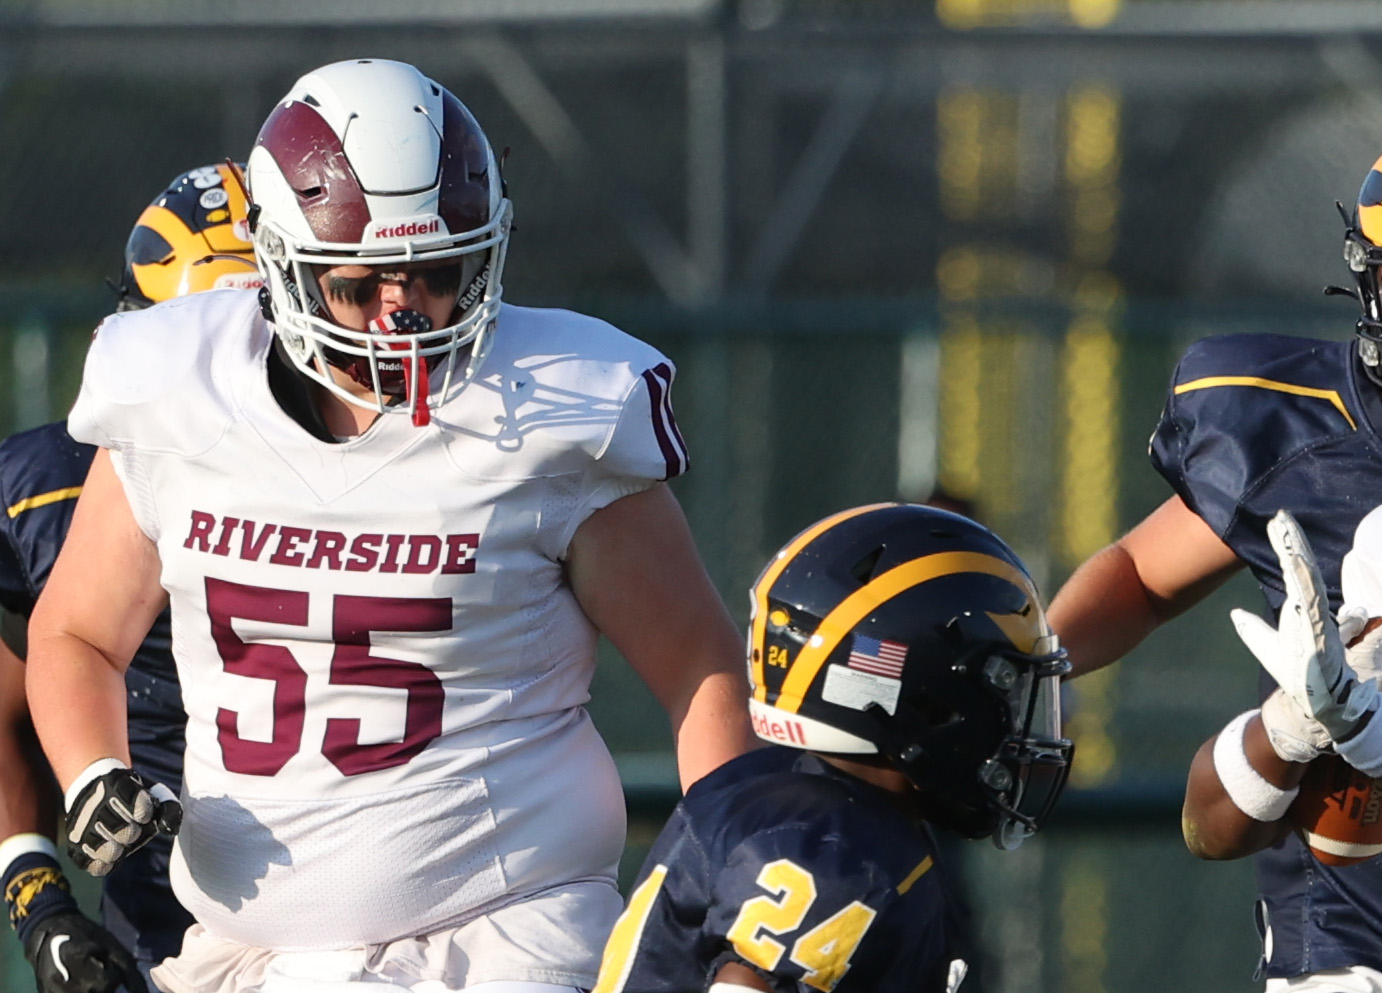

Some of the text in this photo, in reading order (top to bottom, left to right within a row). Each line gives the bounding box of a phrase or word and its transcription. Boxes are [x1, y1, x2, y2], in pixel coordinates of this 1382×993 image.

[375, 219, 439, 239] Riddell
[183, 509, 481, 575] RIVERSIDE
[203, 575, 453, 777] 55
[767, 645, 789, 669] 24
[725, 858, 878, 993] 24
